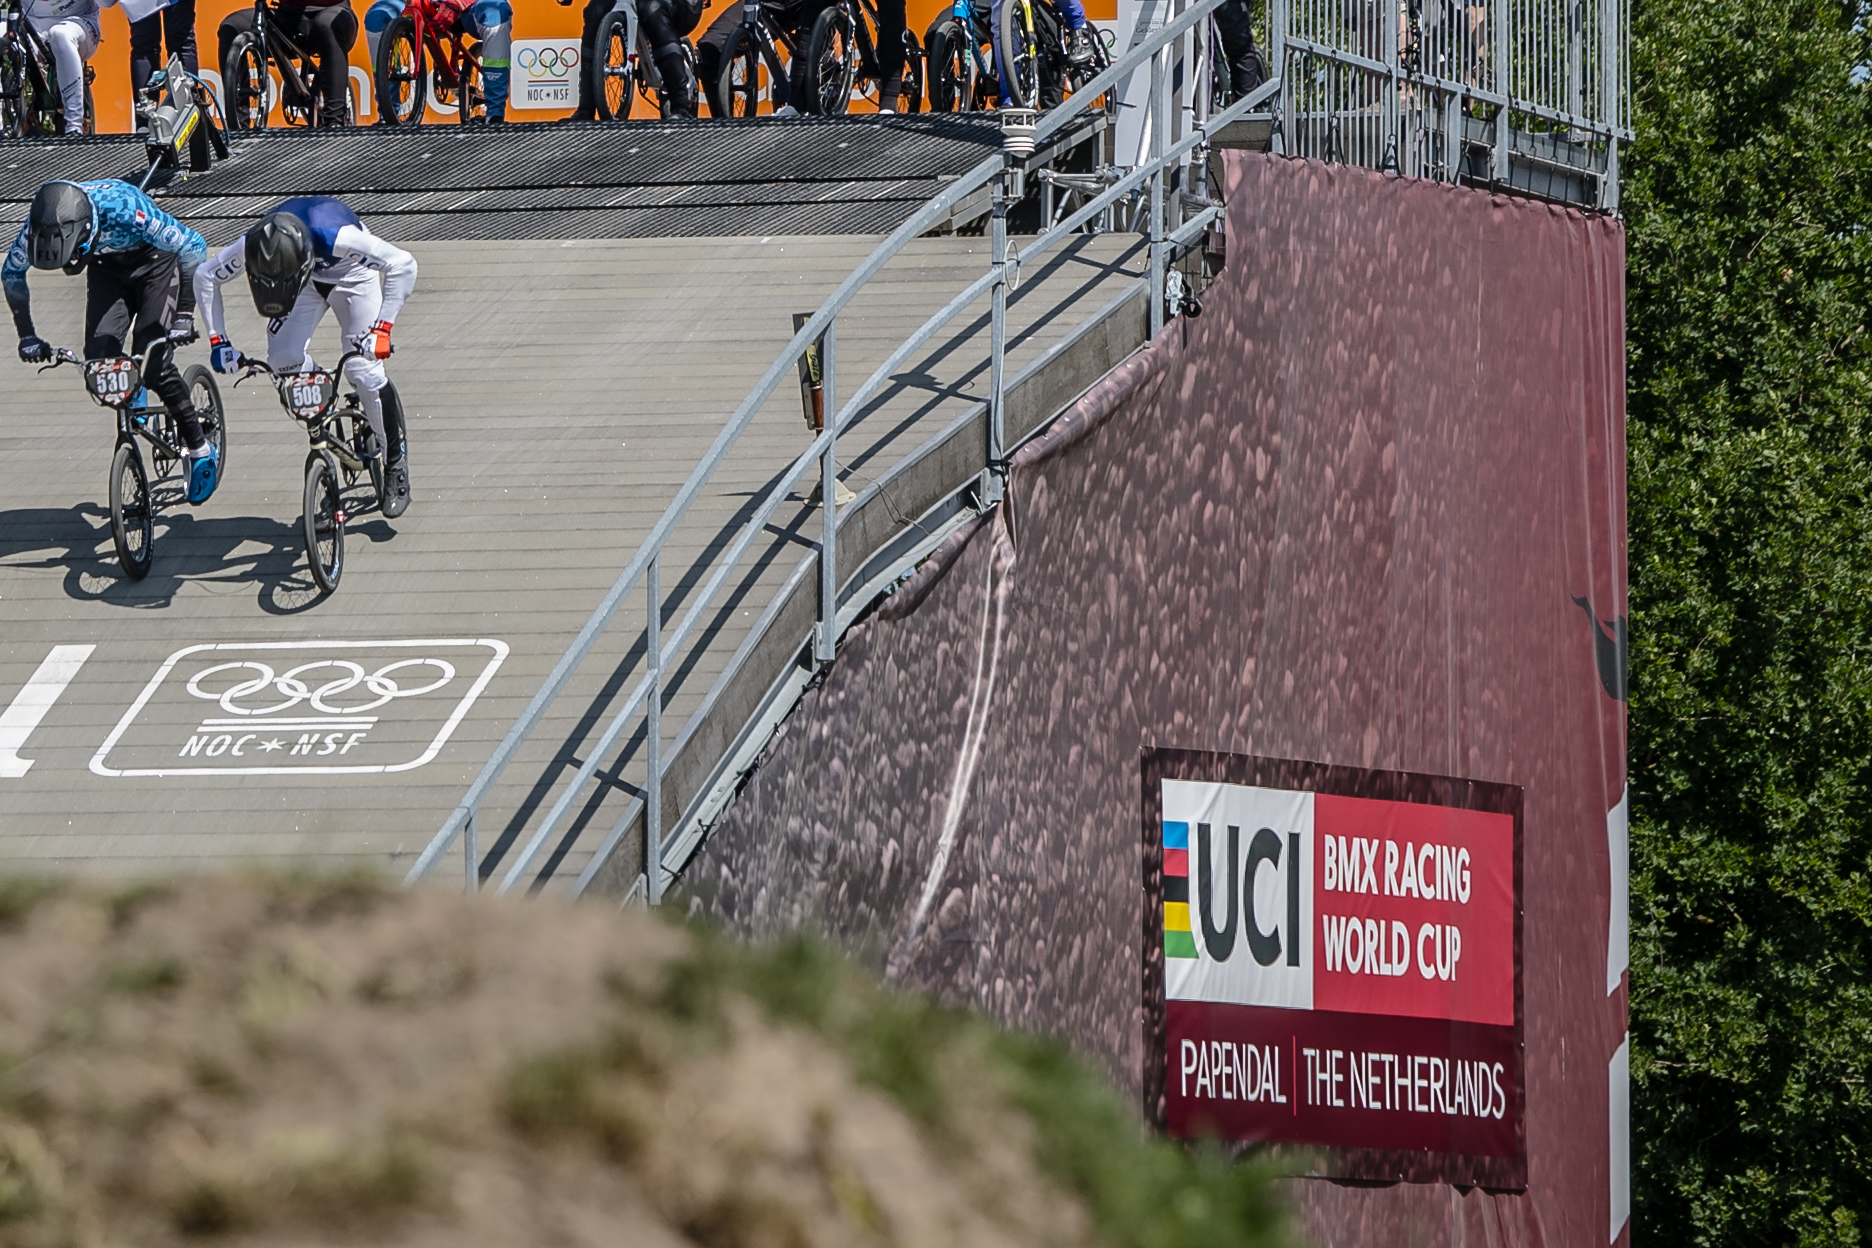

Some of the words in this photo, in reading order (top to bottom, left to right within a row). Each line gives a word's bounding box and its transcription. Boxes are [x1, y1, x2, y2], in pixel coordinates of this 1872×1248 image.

[36, 249, 59, 262] FLY
[214, 257, 242, 281] CIC
[96, 371, 129, 394] 530
[292, 385, 322, 406] 508
[178, 733, 257, 757] NOC
[289, 732, 368, 756] NSF
[1324, 834, 1379, 895] BMX
[1384, 840, 1471, 904] RACING
[1197, 822, 1301, 968] UCI
[1322, 914, 1411, 977] WORLD
[1416, 922, 1461, 982] CUP
[1181, 1038, 1287, 1104] PAPENDAL
[1302, 1047, 1344, 1107] THE
[1350, 1051, 1506, 1120] NETHERLANDS
